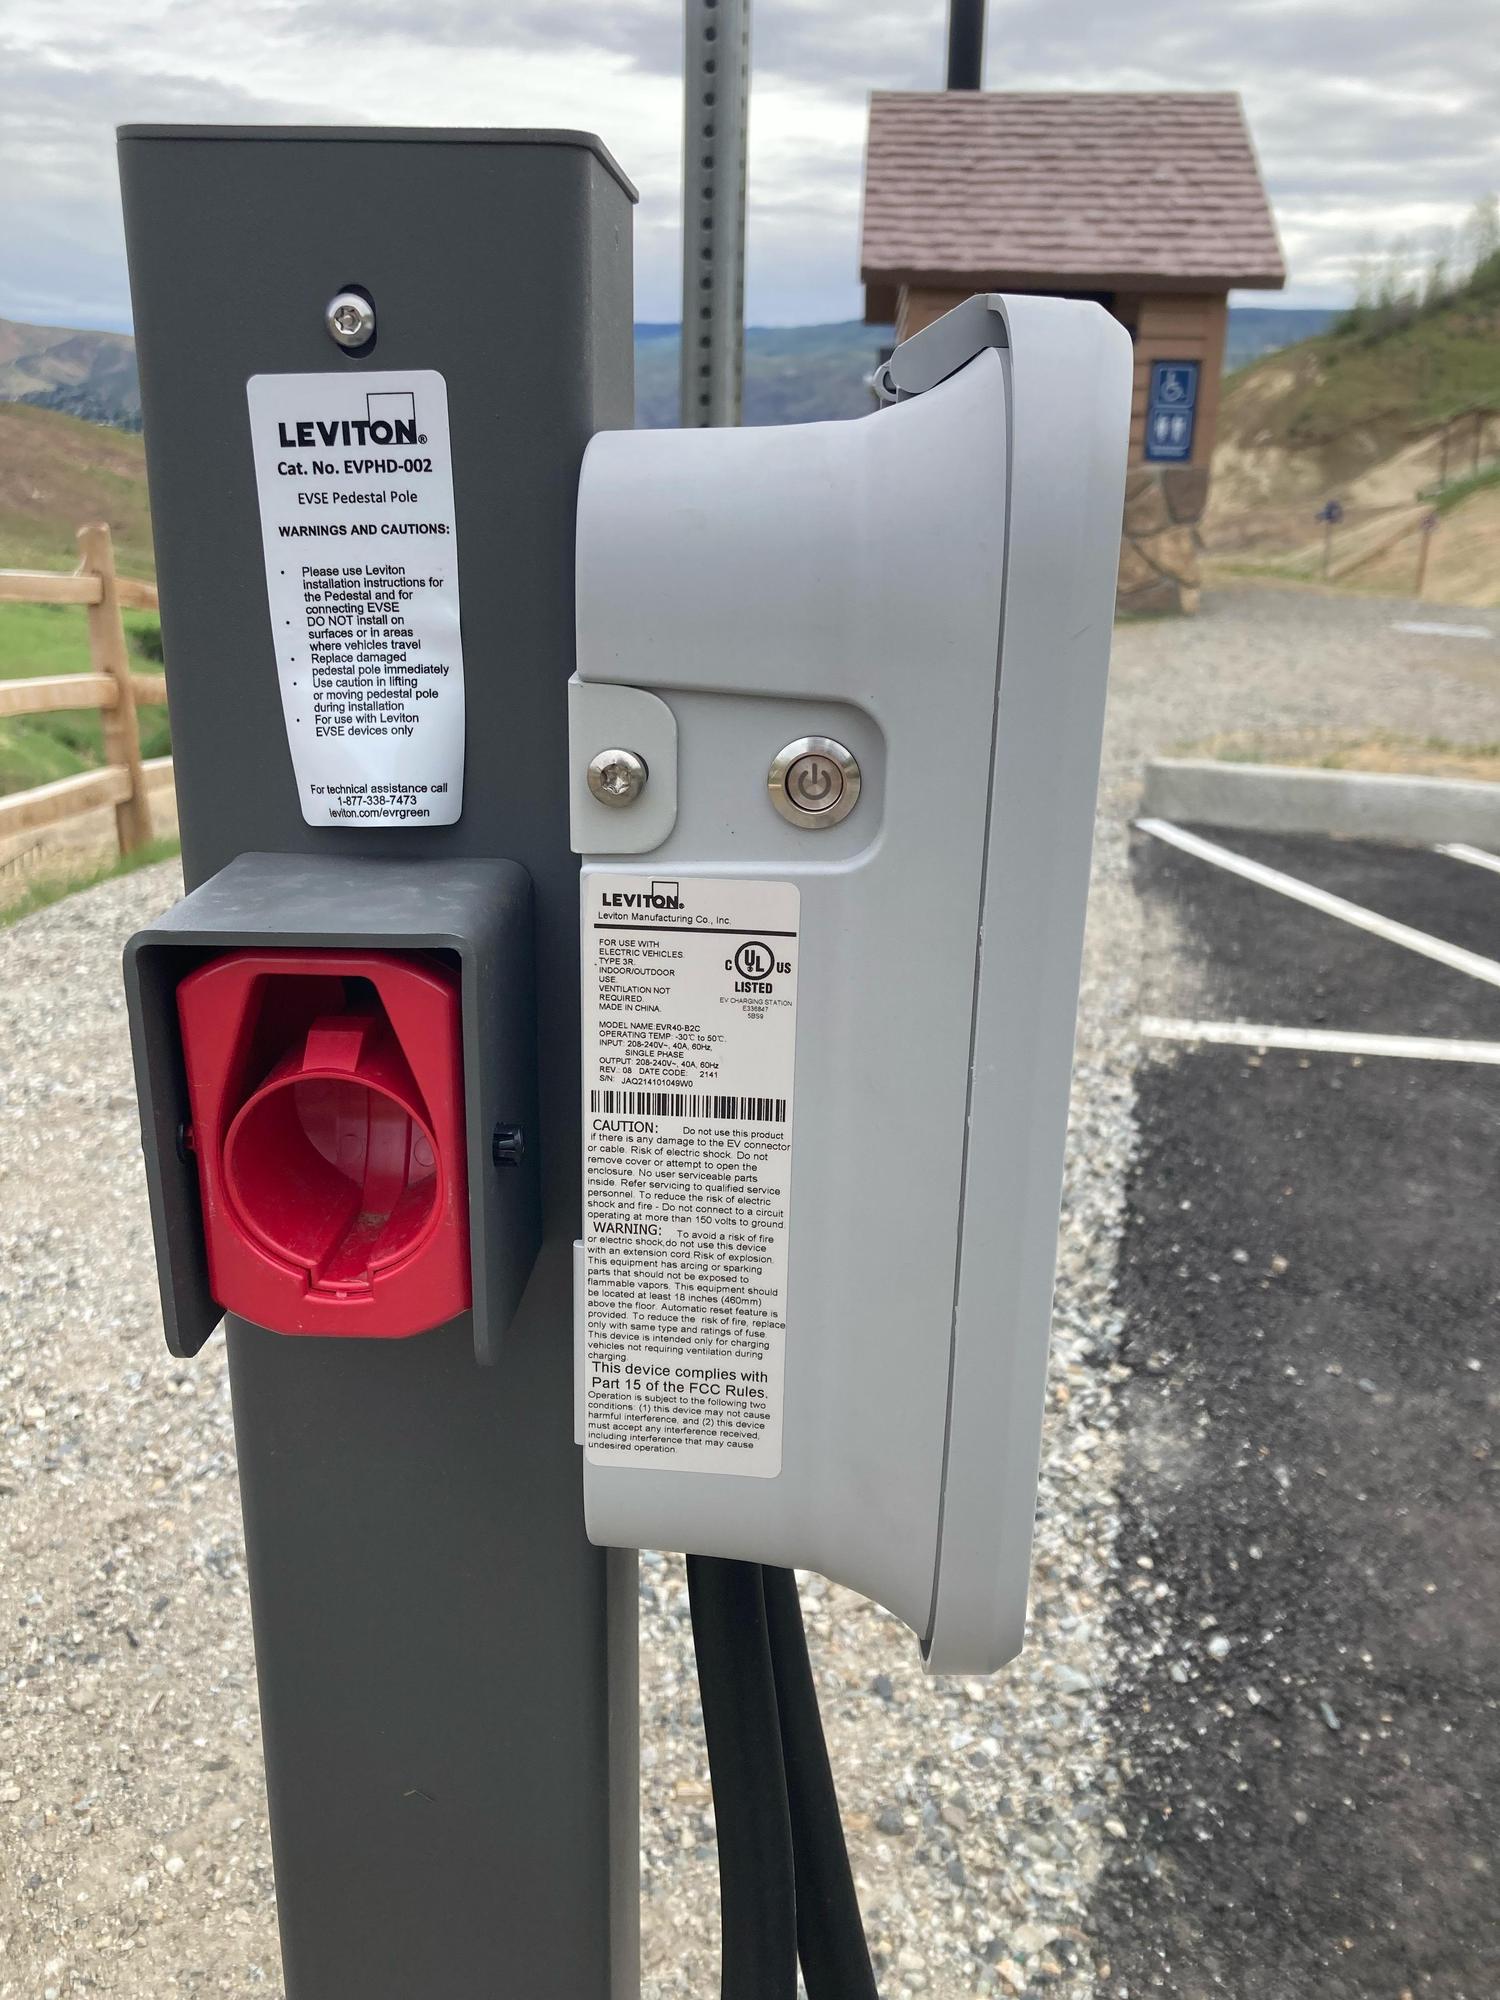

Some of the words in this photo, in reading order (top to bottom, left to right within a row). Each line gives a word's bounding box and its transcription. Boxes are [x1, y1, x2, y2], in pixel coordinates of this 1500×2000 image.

[277, 461, 307, 475] Cat.
[312, 460, 339, 475] No.
[343, 458, 432, 474] EVPHD-002
[297, 491, 328, 504] EVSE
[332, 490, 386, 504] Pedestal
[390, 490, 417, 502] Pole
[278, 525, 347, 537] WARNINGS
[350, 524, 377, 535] AND
[380, 523, 449, 535] CAUTIONS:
[302, 566, 339, 577] Please
[342, 567, 362, 576] use
[365, 565, 405, 575] Leviton
[302, 578, 360, 589] installation
[363, 577, 425, 588] instructions
[428, 577, 444, 587] for
[304, 591, 321, 602] the
[324, 590, 371, 601] Pedestal
[374, 590, 395, 600] and
[397, 590, 413, 600] for
[305, 603, 364, 614] connecting
[366, 602, 399, 612] EVSE
[307, 616, 325, 627] DO
[327, 615, 352, 626] NOT
[356, 615, 388, 625] install
[390, 616, 404, 625] on
[308, 628, 353, 639] surfaces
[355, 629, 367, 637] or
[370, 627, 379, 637] in
[382, 628, 413, 637] areas
[309, 641, 341, 651] where
[344, 640, 388, 650] vehicles
[390, 639, 421, 649] travel
[311, 653, 353, 665] Replace
[356, 652, 406, 663] damaged
[312, 665, 355, 676] pedestal
[358, 665, 381, 676] pole
[383, 664, 449, 676] immediately
[312, 677, 333, 688] Use
[335, 677, 373, 687] caution
[376, 677, 386, 686] in
[388, 677, 417, 688] lifting
[313, 691, 323, 700] or
[326, 689, 363, 700] moving
[366, 689, 412, 700] pedestal
[415, 689, 438, 700] pole
[313, 702, 345, 713] during
[347, 701, 404, 711] installation
[315, 714, 332, 724] For
[333, 715, 352, 724] use
[355, 714, 376, 723] with
[379, 713, 419, 723] Leviton
[315, 726, 344, 737] EVSE
[347, 726, 388, 735] devices
[390, 725, 413, 737] only
[310, 784, 325, 794] For
[326, 783, 367, 794] technical
[370, 783, 428, 793] assistance
[430, 783, 448, 793] call
[337, 795, 417, 806] 1-877-338-7473
[598, 911, 628, 920] Leviton
[631, 912, 693, 924] Manufacturing
[598, 938, 616, 946] FOR
[618, 939, 635, 947] USE
[637, 940, 659, 948] WITH
[598, 948, 640, 956] ELECTRIC
[599, 957, 620, 965] TYPE
[776, 962, 792, 974] US
[599, 985, 651, 993] VENTILATION
[653, 986, 671, 994] NOT
[734, 981, 773, 994] LISTED
[598, 1021, 628, 1029] MODEL
[598, 1030, 646, 1039] OPERATING
[625, 1049, 654, 1057] SINGLE
[656, 1050, 684, 1058] PHASE
[699, 1061, 719, 1069] 60Hz
[638, 1067, 660, 1075] DATE
[699, 1070, 717, 1078] 2141
[592, 1119, 658, 1133] CAUTION:
[682, 1126, 695, 1134] Do
[697, 1127, 712, 1135] not
[732, 1129, 748, 1137] this
[750, 1130, 784, 1139] product
[593, 1221, 661, 1236] WARNING:
[677, 1230, 689, 1238] To
[691, 1231, 716, 1239] avoid
[728, 1232, 745, 1241] risk
[747, 1234, 756, 1242] of
[758, 1234, 774, 1243] fire
[601, 1289, 634, 1298] located
[637, 1291, 646, 1299] at
[649, 1291, 671, 1300] least
[674, 1293, 685, 1301] 18
[688, 1293, 718, 1303] inches
[720, 1295, 761, 1307] (460mm)
[592, 1360, 620, 1373] This
[624, 1362, 670, 1376] device
[674, 1367, 736, 1381] complies
[740, 1370, 767, 1383] with
[592, 1376, 619, 1389] Part
[625, 1378, 641, 1390] 15
[645, 1379, 659, 1391] of
[662, 1380, 684, 1393] the
[689, 1382, 720, 1395] FCC
[725, 1384, 767, 1399] Rules.
[588, 1441, 631, 1450] undesired
